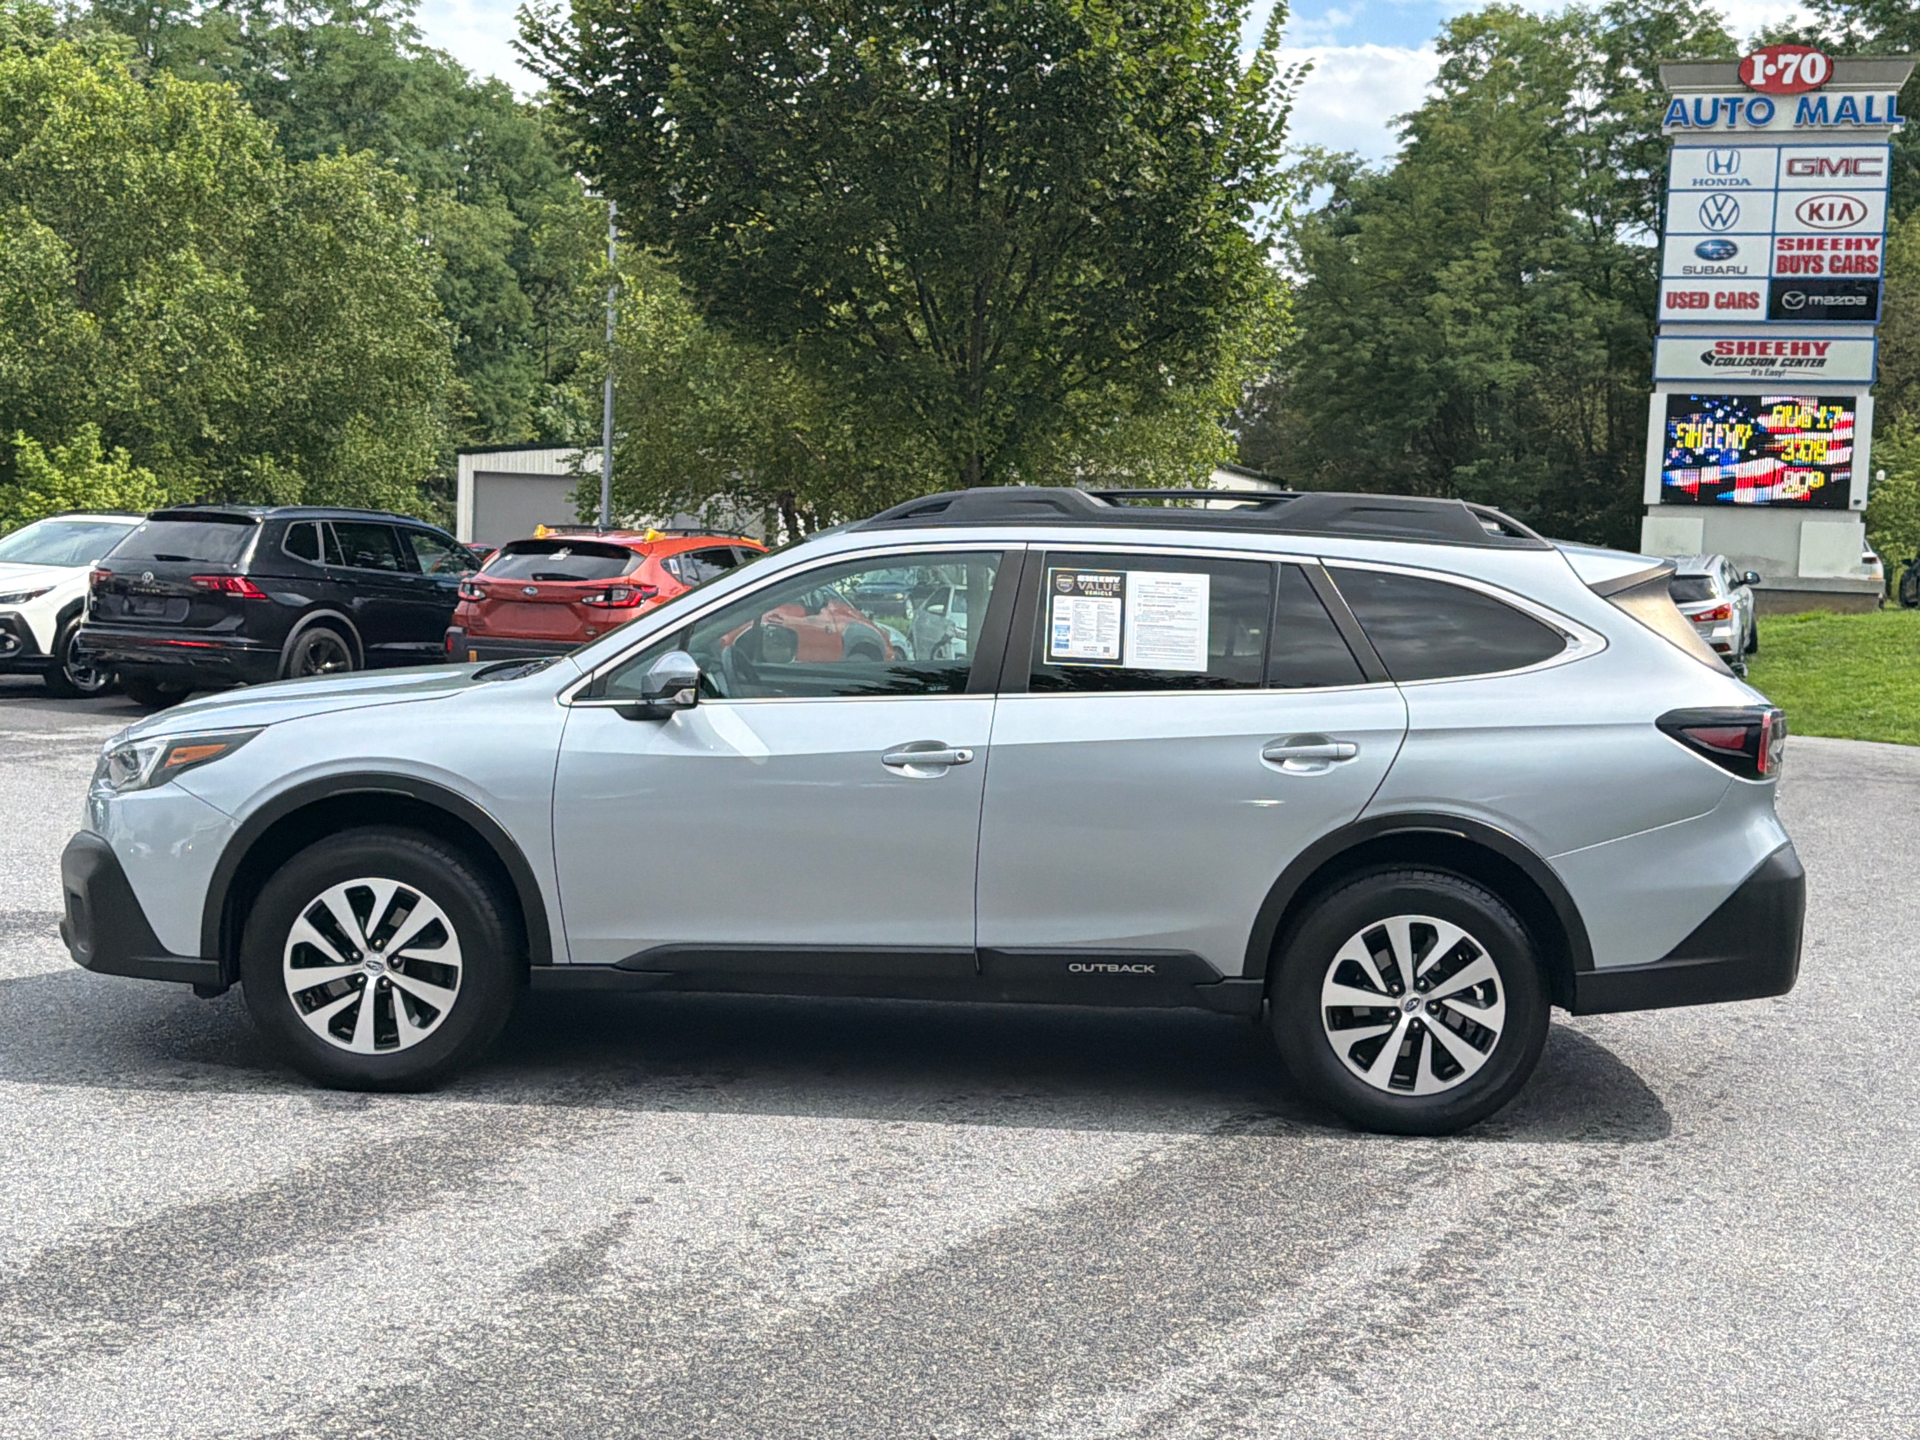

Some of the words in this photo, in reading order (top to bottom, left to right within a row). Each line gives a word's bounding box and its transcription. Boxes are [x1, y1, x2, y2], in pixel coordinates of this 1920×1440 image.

[1663, 97, 1775, 127] AUTO
[1793, 94, 1905, 126] MALL
[1786, 157, 1883, 177] GMC
[1692, 178, 1751, 186] HONDA
[1808, 202, 1855, 221] KIA
[1776, 238, 1881, 251] SHEEHY
[1682, 265, 1748, 275] SUBARU
[1776, 255, 1824, 274] BUYS
[1829, 254, 1879, 274] CARS
[1666, 292, 1710, 309] USED
[1714, 292, 1760, 309] CARS
[1808, 296, 1867, 305] mazda
[1714, 340, 1831, 356] SHEEHY
[1714, 357, 1778, 367] COLLISION
[1779, 358, 1827, 368] CENTER
[1750, 368, 1762, 376] It's
[1764, 368, 1787, 377] Easy!
[1773, 405, 1812, 428] AUG
[1676, 423, 1753, 450] SHEEHY
[1077, 582, 1121, 591] VALUE
[1068, 963, 1156, 974] OUTBACK
